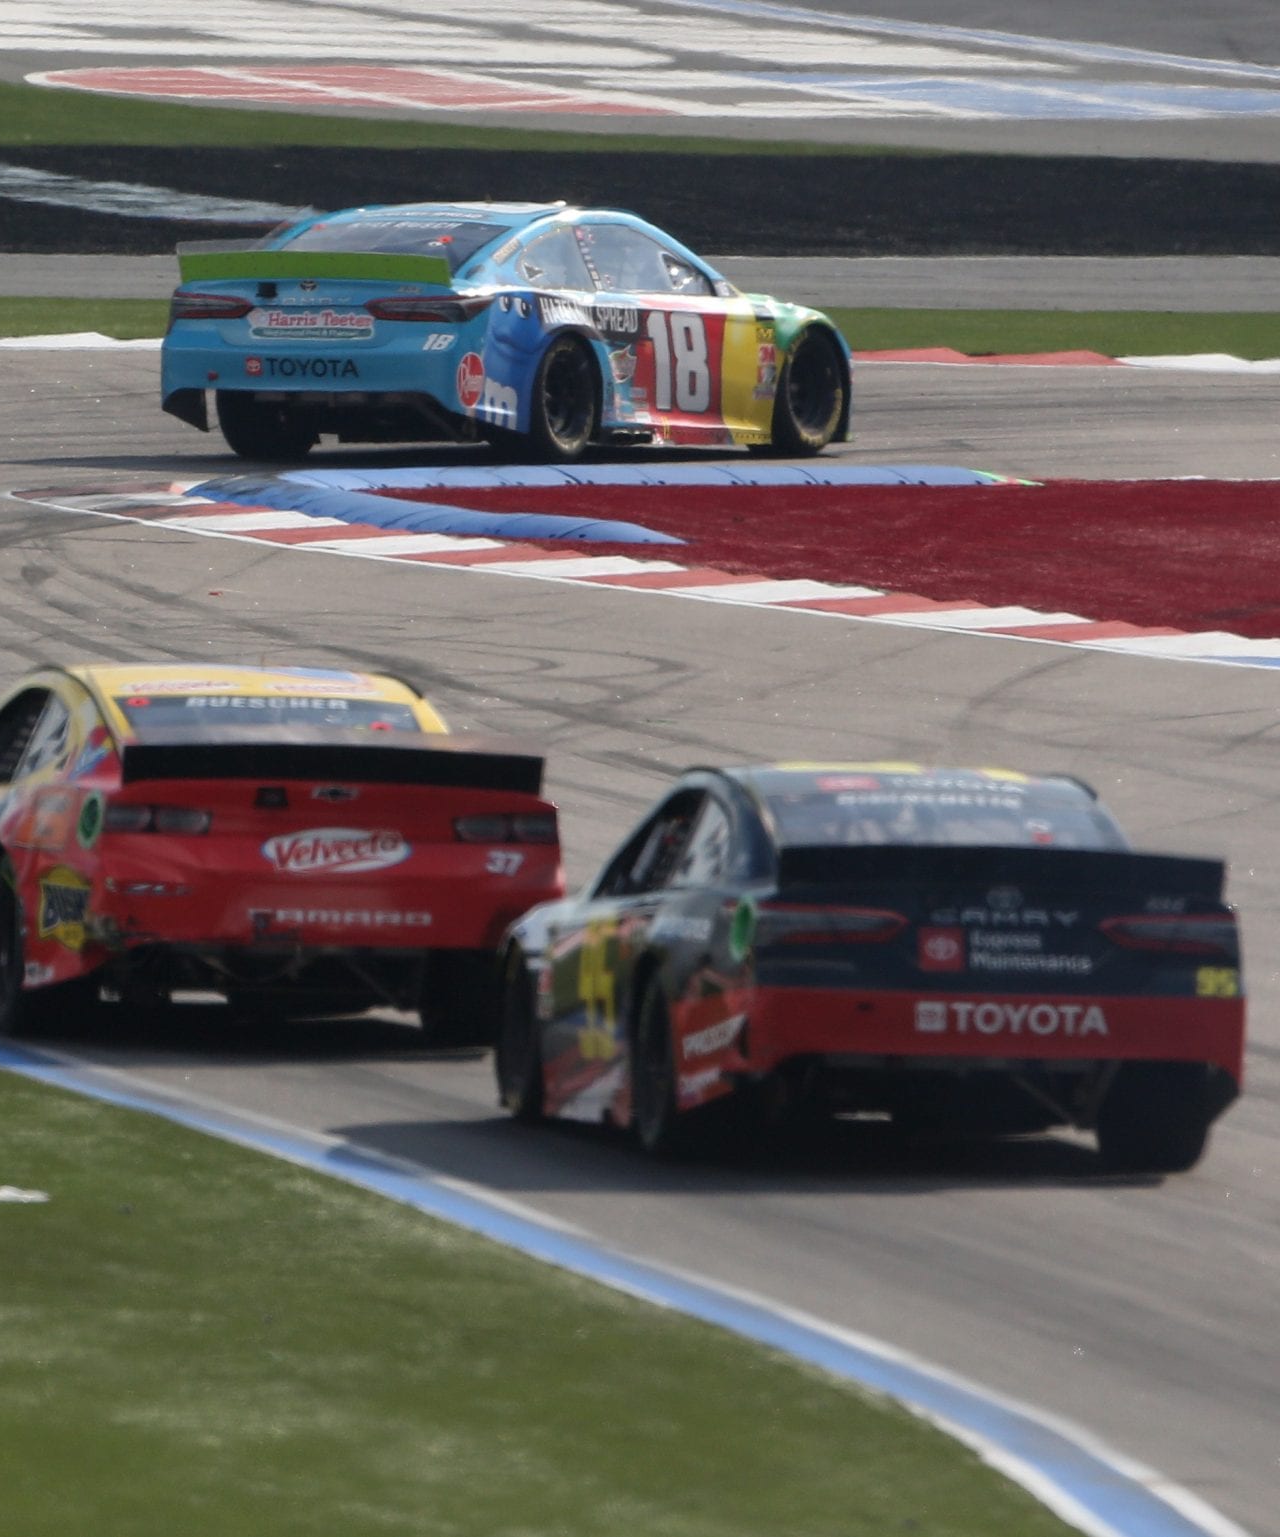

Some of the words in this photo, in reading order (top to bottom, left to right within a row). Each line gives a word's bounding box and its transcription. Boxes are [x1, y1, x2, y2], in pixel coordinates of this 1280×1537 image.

[268, 312, 317, 326] Harris
[321, 311, 373, 326] Teeter
[596, 306, 638, 333] SPREAD
[422, 333, 455, 351] 18
[266, 357, 359, 378] TOYOTA
[646, 310, 709, 413] 18
[185, 696, 349, 710] BUESCHER
[272, 831, 407, 871] Velveeta
[485, 849, 525, 876] 37
[1195, 966, 1238, 997] 95
[951, 1003, 1108, 1036] TOYOTA
